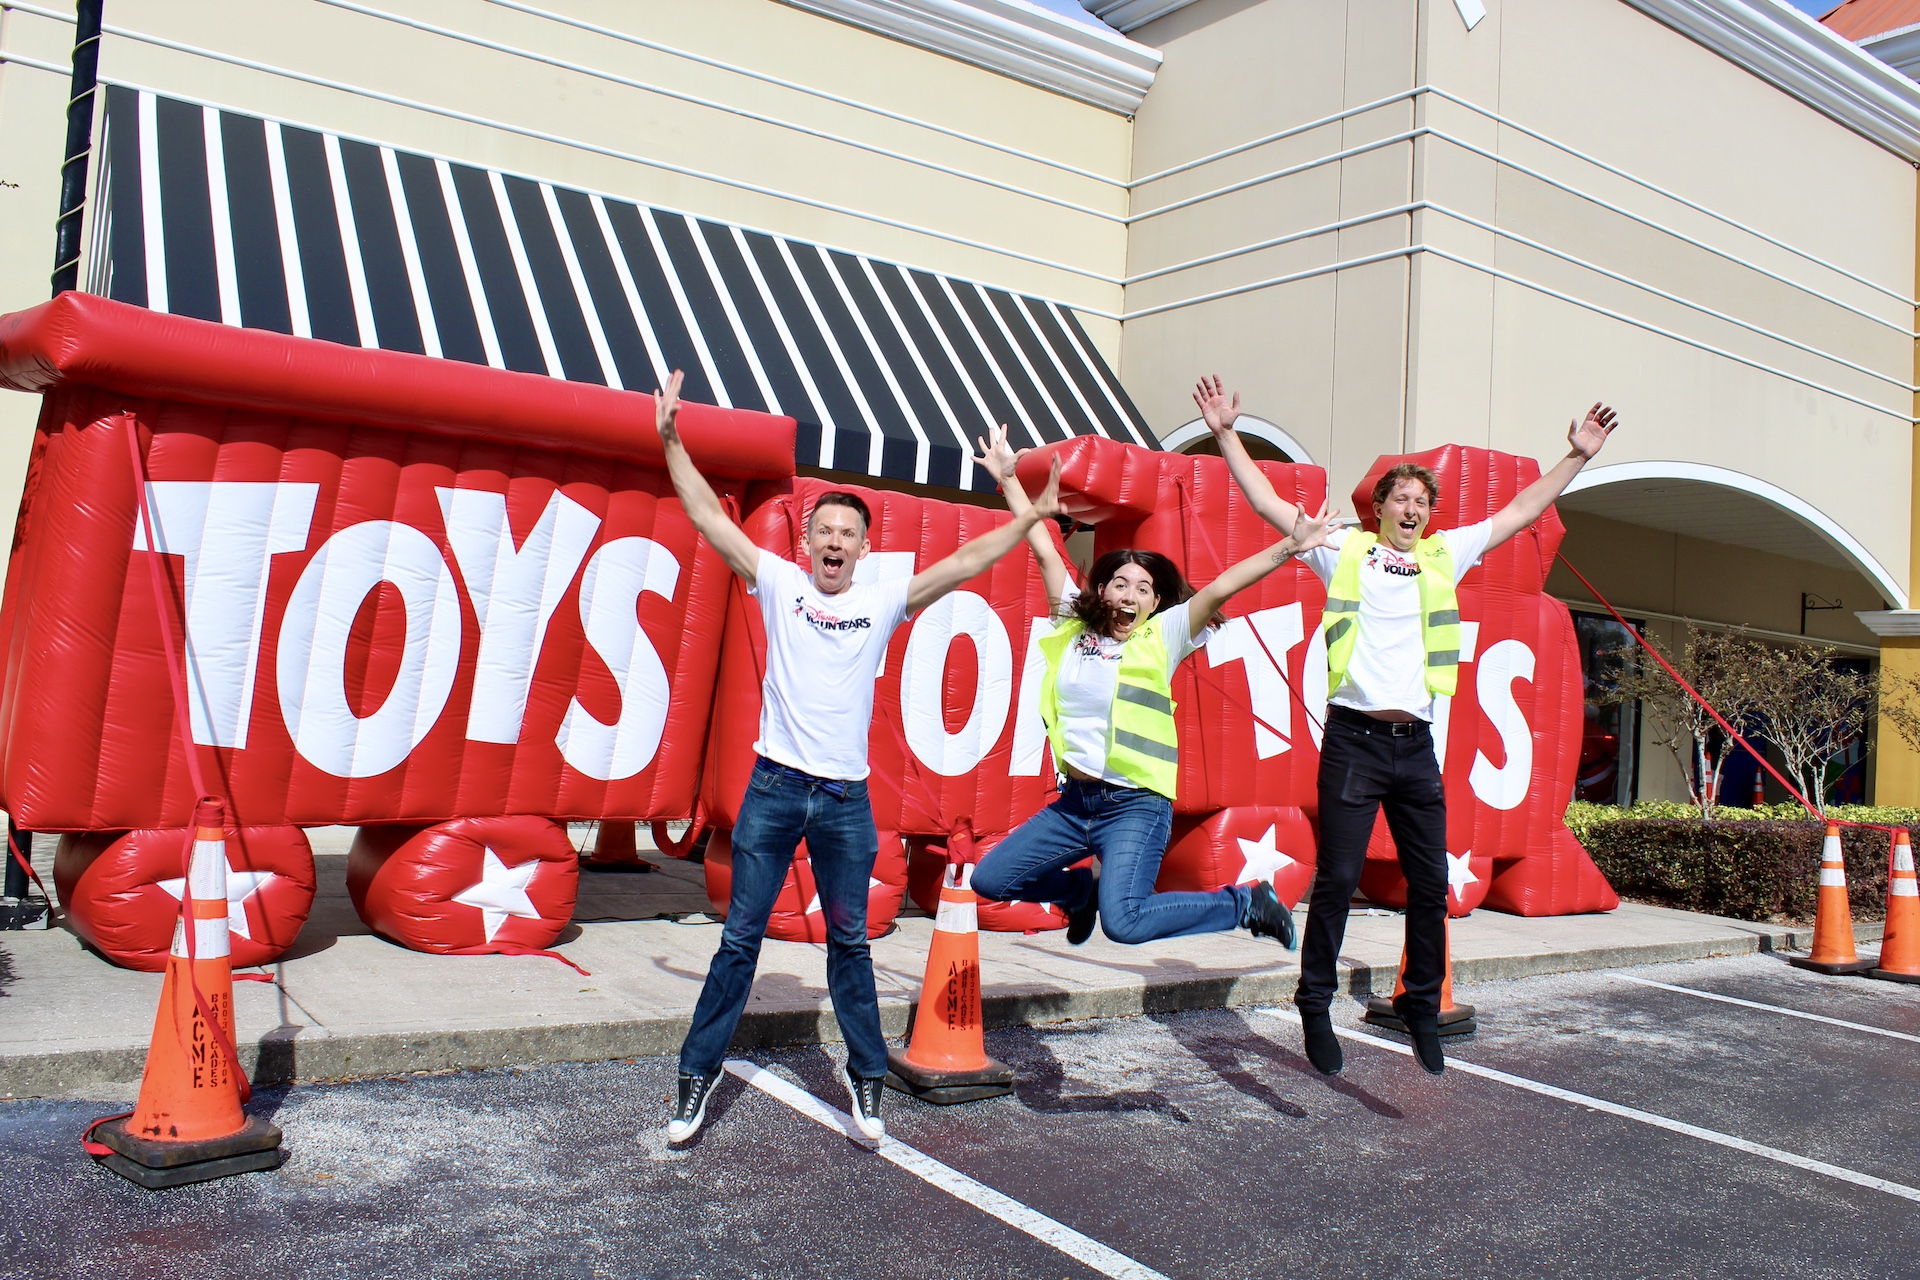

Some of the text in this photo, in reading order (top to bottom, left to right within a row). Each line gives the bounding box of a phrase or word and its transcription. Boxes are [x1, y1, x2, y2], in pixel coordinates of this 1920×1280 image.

[133, 481, 681, 780] TOYS
[1206, 601, 1536, 810] TS
[947, 960, 958, 1030] ACME
[960, 959, 969, 1031] BARRICADES
[192, 1003, 205, 1088] ACME
[210, 993, 220, 1088] BACADES
